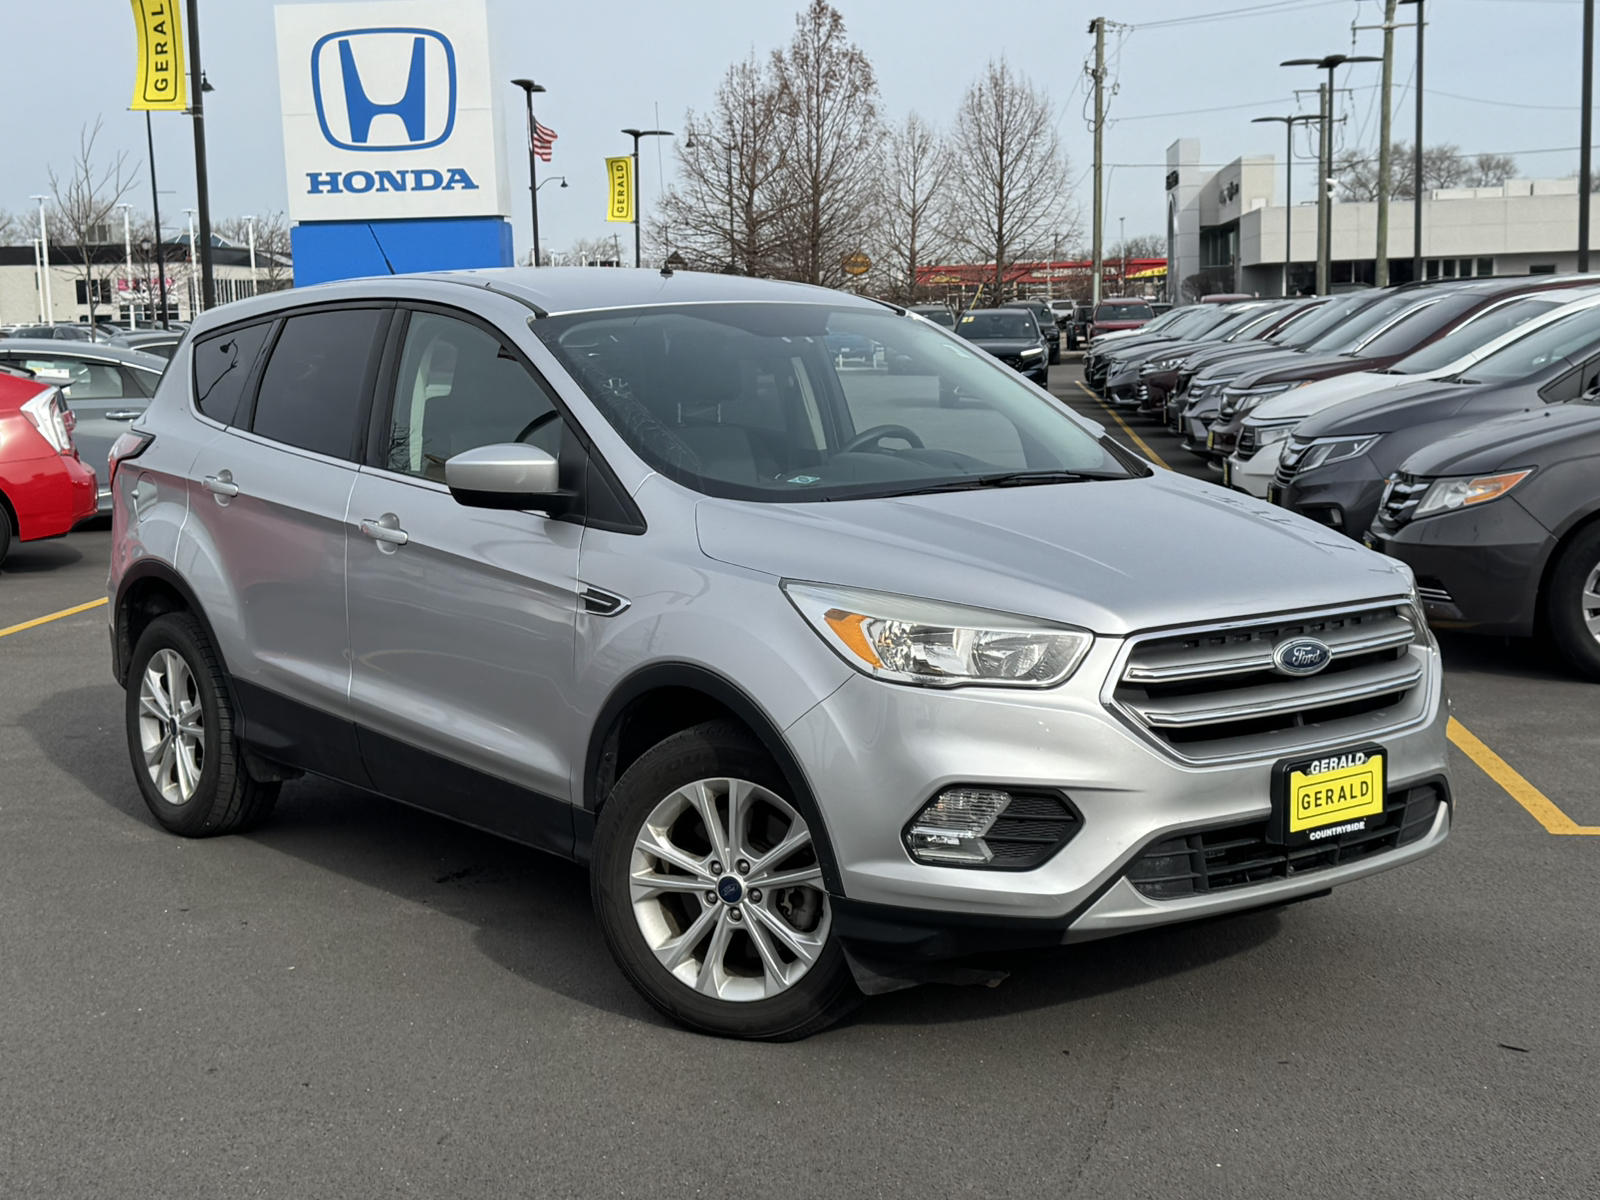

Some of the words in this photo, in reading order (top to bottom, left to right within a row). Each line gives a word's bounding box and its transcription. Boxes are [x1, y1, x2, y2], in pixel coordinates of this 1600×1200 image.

[306, 168, 479, 194] HONDA
[616, 164, 625, 214] GERALD
[1293, 646, 1321, 665] Ford
[1310, 752, 1365, 775] GERALD
[1301, 781, 1369, 810] GERALD
[1309, 821, 1365, 841] COUNTRYSIDE
